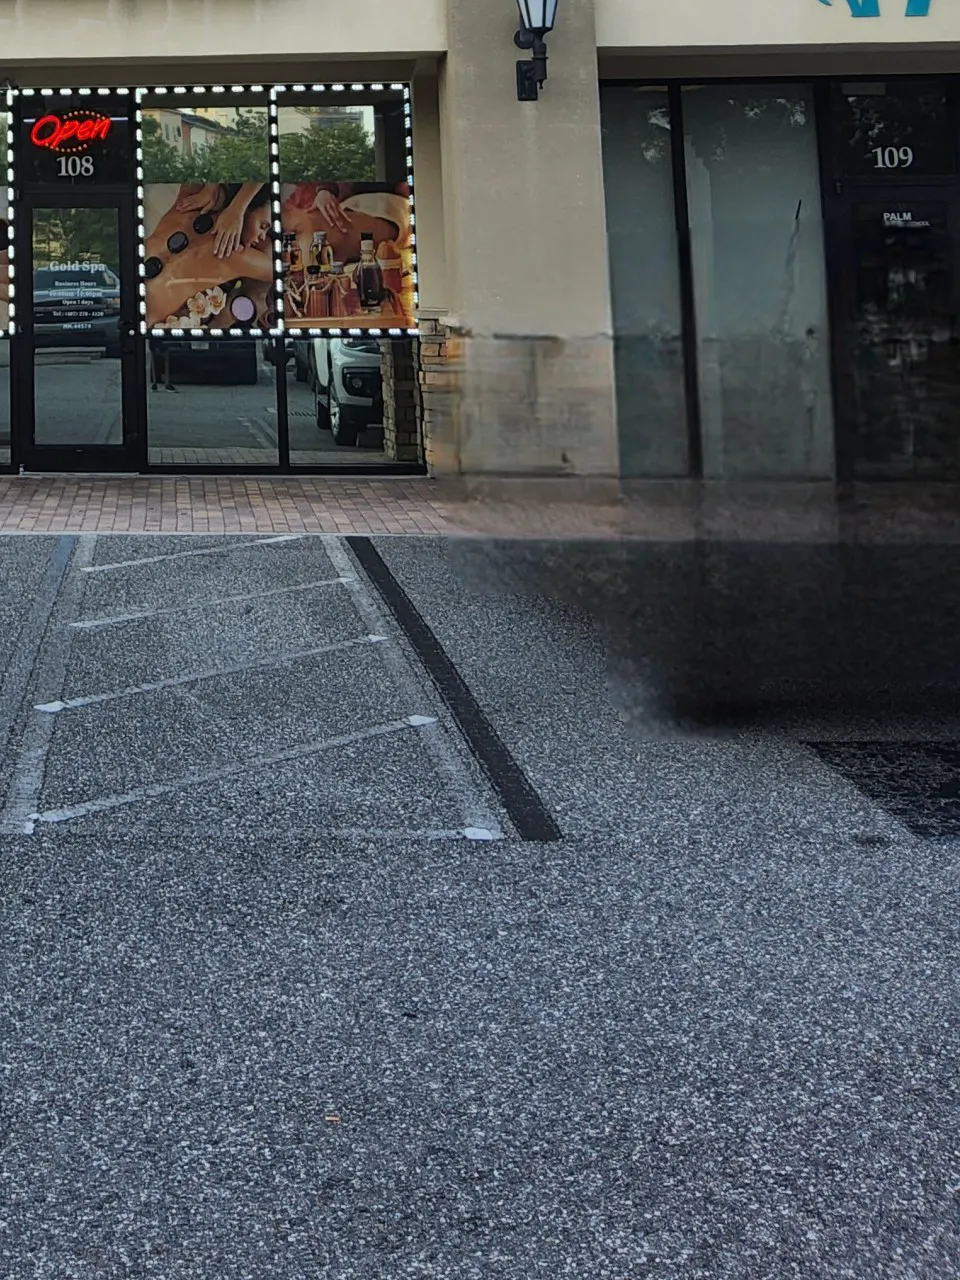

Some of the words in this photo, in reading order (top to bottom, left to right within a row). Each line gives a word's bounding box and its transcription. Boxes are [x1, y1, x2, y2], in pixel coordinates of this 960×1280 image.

[31, 114, 112, 149] Open
[56, 155, 94, 176] 108
[871, 146, 914, 168] 109
[883, 212, 912, 221] PALM
[50, 261, 79, 271] Gold
[82, 261, 106, 273] Spa
